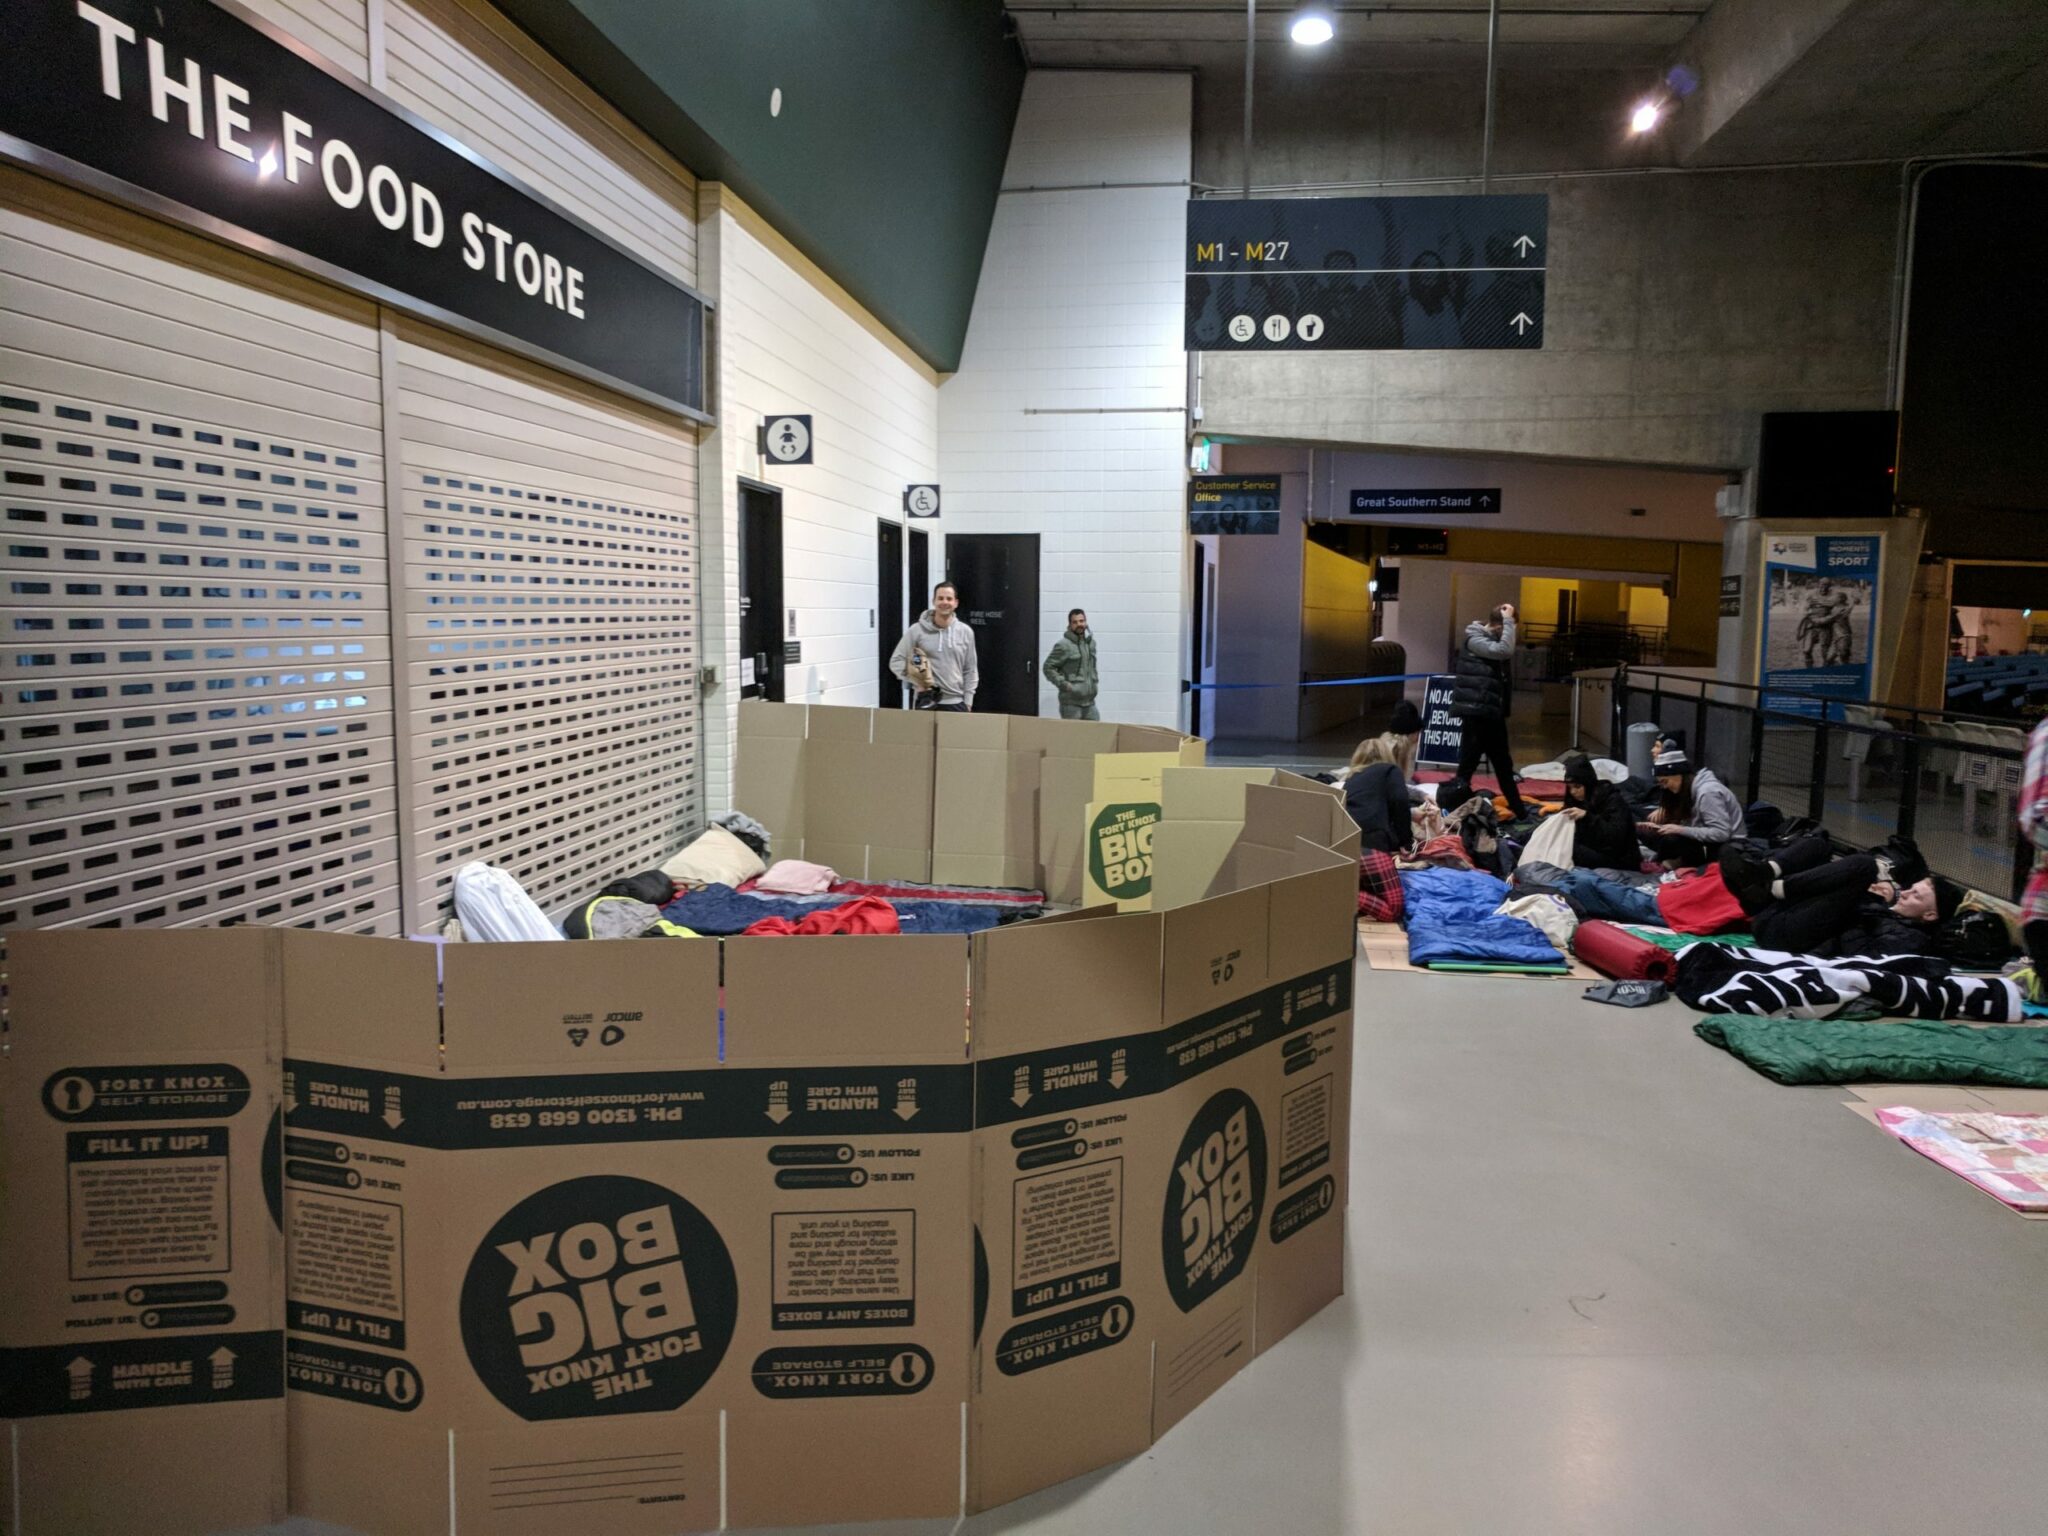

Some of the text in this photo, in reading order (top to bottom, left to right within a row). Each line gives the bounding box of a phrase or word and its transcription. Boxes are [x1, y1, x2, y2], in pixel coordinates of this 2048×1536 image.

[77, 0, 585, 320] THE FOOD STORE
[1197, 243, 1223, 262] M1
[1245, 241, 1289, 261] M27
[1196, 481, 1276, 490] Customer Service
[1195, 493, 1221, 502] Office
[1356, 495, 1472, 507] Great Southern Stand
[1828, 557, 1870, 566] SPORT
[1429, 689, 1442, 704] NO
[1424, 730, 1462, 746] THIS POIN
[1115, 810, 1136, 822] THE
[1099, 813, 1157, 837] FORT KNOX
[1100, 825, 1152, 866] BIG
[603, 1011, 643, 1022] amcor
[1112, 1048, 1126, 1058] UP
[1014, 1065, 1030, 1075] UP
[1043, 1064, 1070, 1078] CARE
[1073, 1059, 1098, 1072] WITH
[100, 1076, 225, 1091] FORT KNOX
[769, 1080, 788, 1090] UP
[897, 1077, 916, 1087] UP
[1043, 1070, 1098, 1092] HANDLE
[309, 1081, 369, 1099] WITH CARE
[384, 1086, 400, 1096] UP
[807, 1085, 879, 1097] WITH CARE
[100, 1094, 229, 1106] SELF STORAGE
[310, 1093, 370, 1114] HANDLE
[456, 1091, 705, 1111] www.fortknoxselfstorage.com.au
[806, 1097, 879, 1111] HANDLE
[489, 1106, 683, 1129] PH: 1300 668 638
[88, 1135, 209, 1154] FILL IT UP!
[857, 1149, 920, 1158] FOLLOW US:
[1178, 1105, 1248, 1210] BOX
[871, 1173, 914, 1182] LIKE US:
[1180, 1149, 1252, 1267] BIG
[494, 1204, 680, 1297] BOX
[1186, 1204, 1253, 1288] FORT KNOX
[1211, 1246, 1234, 1280] THE
[1025, 1272, 1108, 1306] FILL IT UP!
[508, 1259, 697, 1368] BIG
[778, 1308, 908, 1321] BOXES AIN'T BOXES
[65, 1317, 113, 1329] FOLLOW
[301, 1310, 391, 1340] FILL IT UP!
[1011, 1315, 1099, 1347] SELF STORAGE
[1013, 1328, 1098, 1364] FORT KNOX
[112, 1360, 193, 1379] HANDLE
[288, 1352, 382, 1377] SELF STORAGE
[526, 1330, 702, 1394] FORT KNOX
[772, 1358, 885, 1370] SELF STORAGE
[113, 1375, 193, 1390] WITH CARE
[211, 1379, 234, 1391] UP
[288, 1366, 382, 1394] FORT KNOX
[591, 1368, 654, 1400] THE
[773, 1373, 885, 1387] FORT KNOX
[69, 1390, 92, 1400] UP
